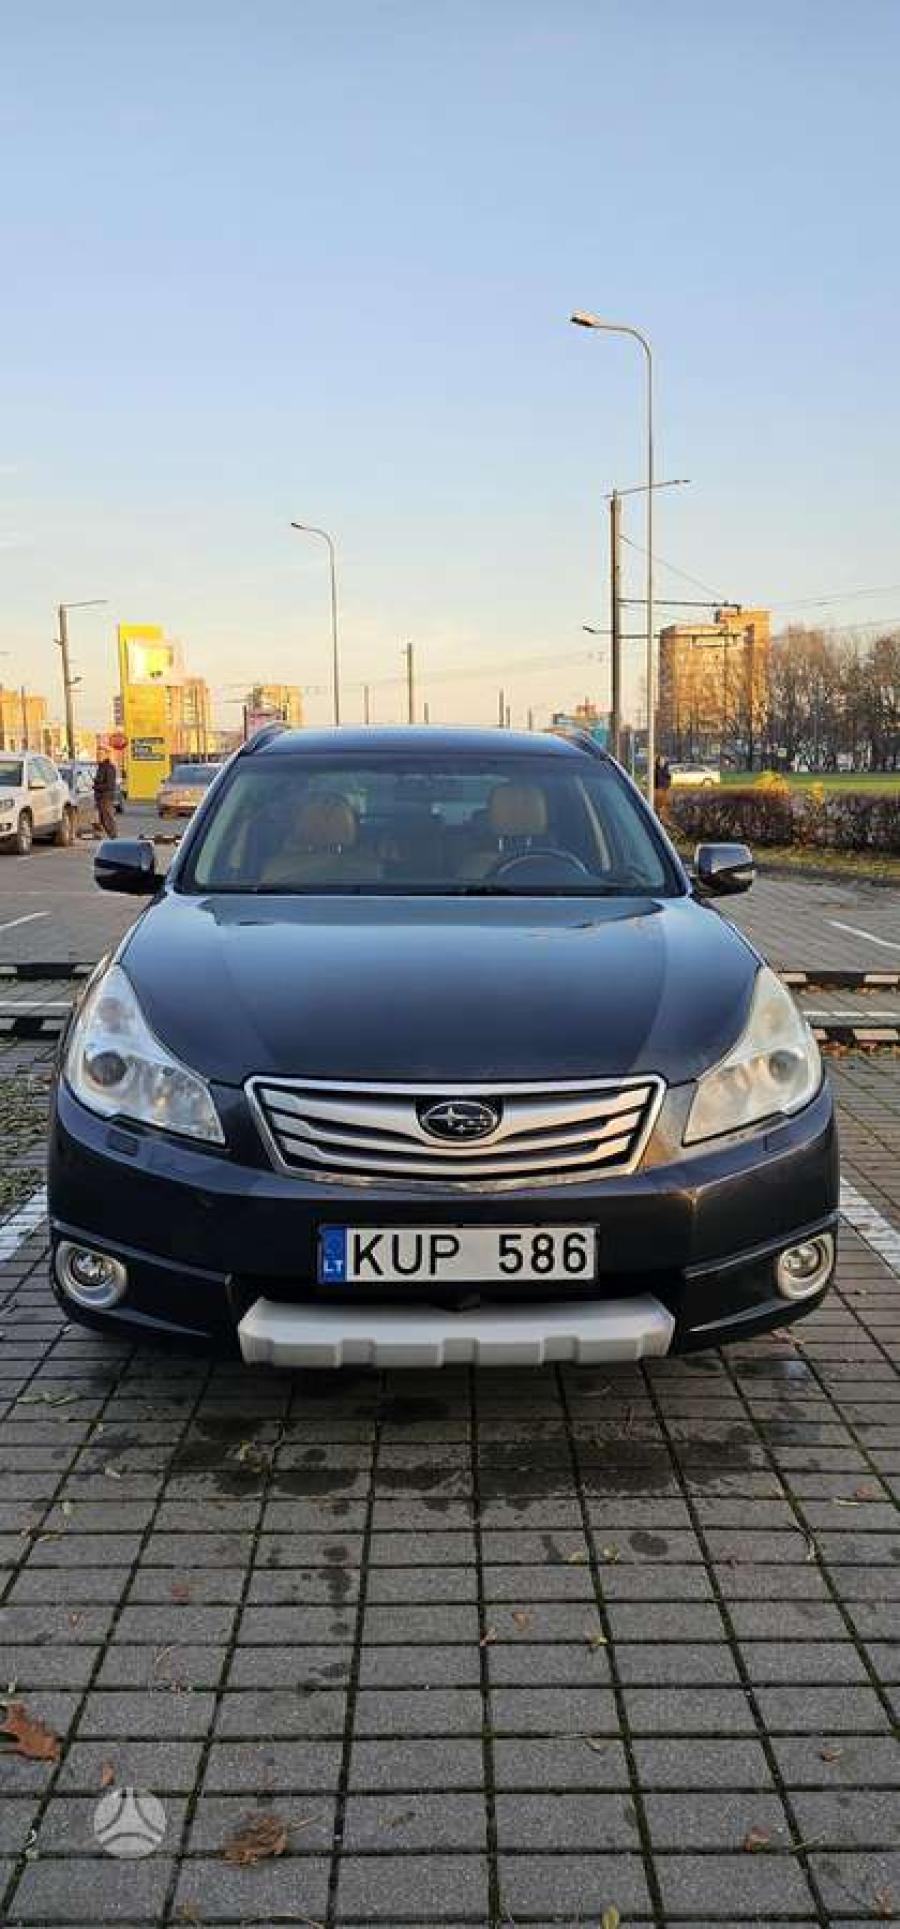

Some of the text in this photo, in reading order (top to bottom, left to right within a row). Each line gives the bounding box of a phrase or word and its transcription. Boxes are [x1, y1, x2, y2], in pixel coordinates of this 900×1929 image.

[323, 1232, 587, 1276] LT KUP 586
